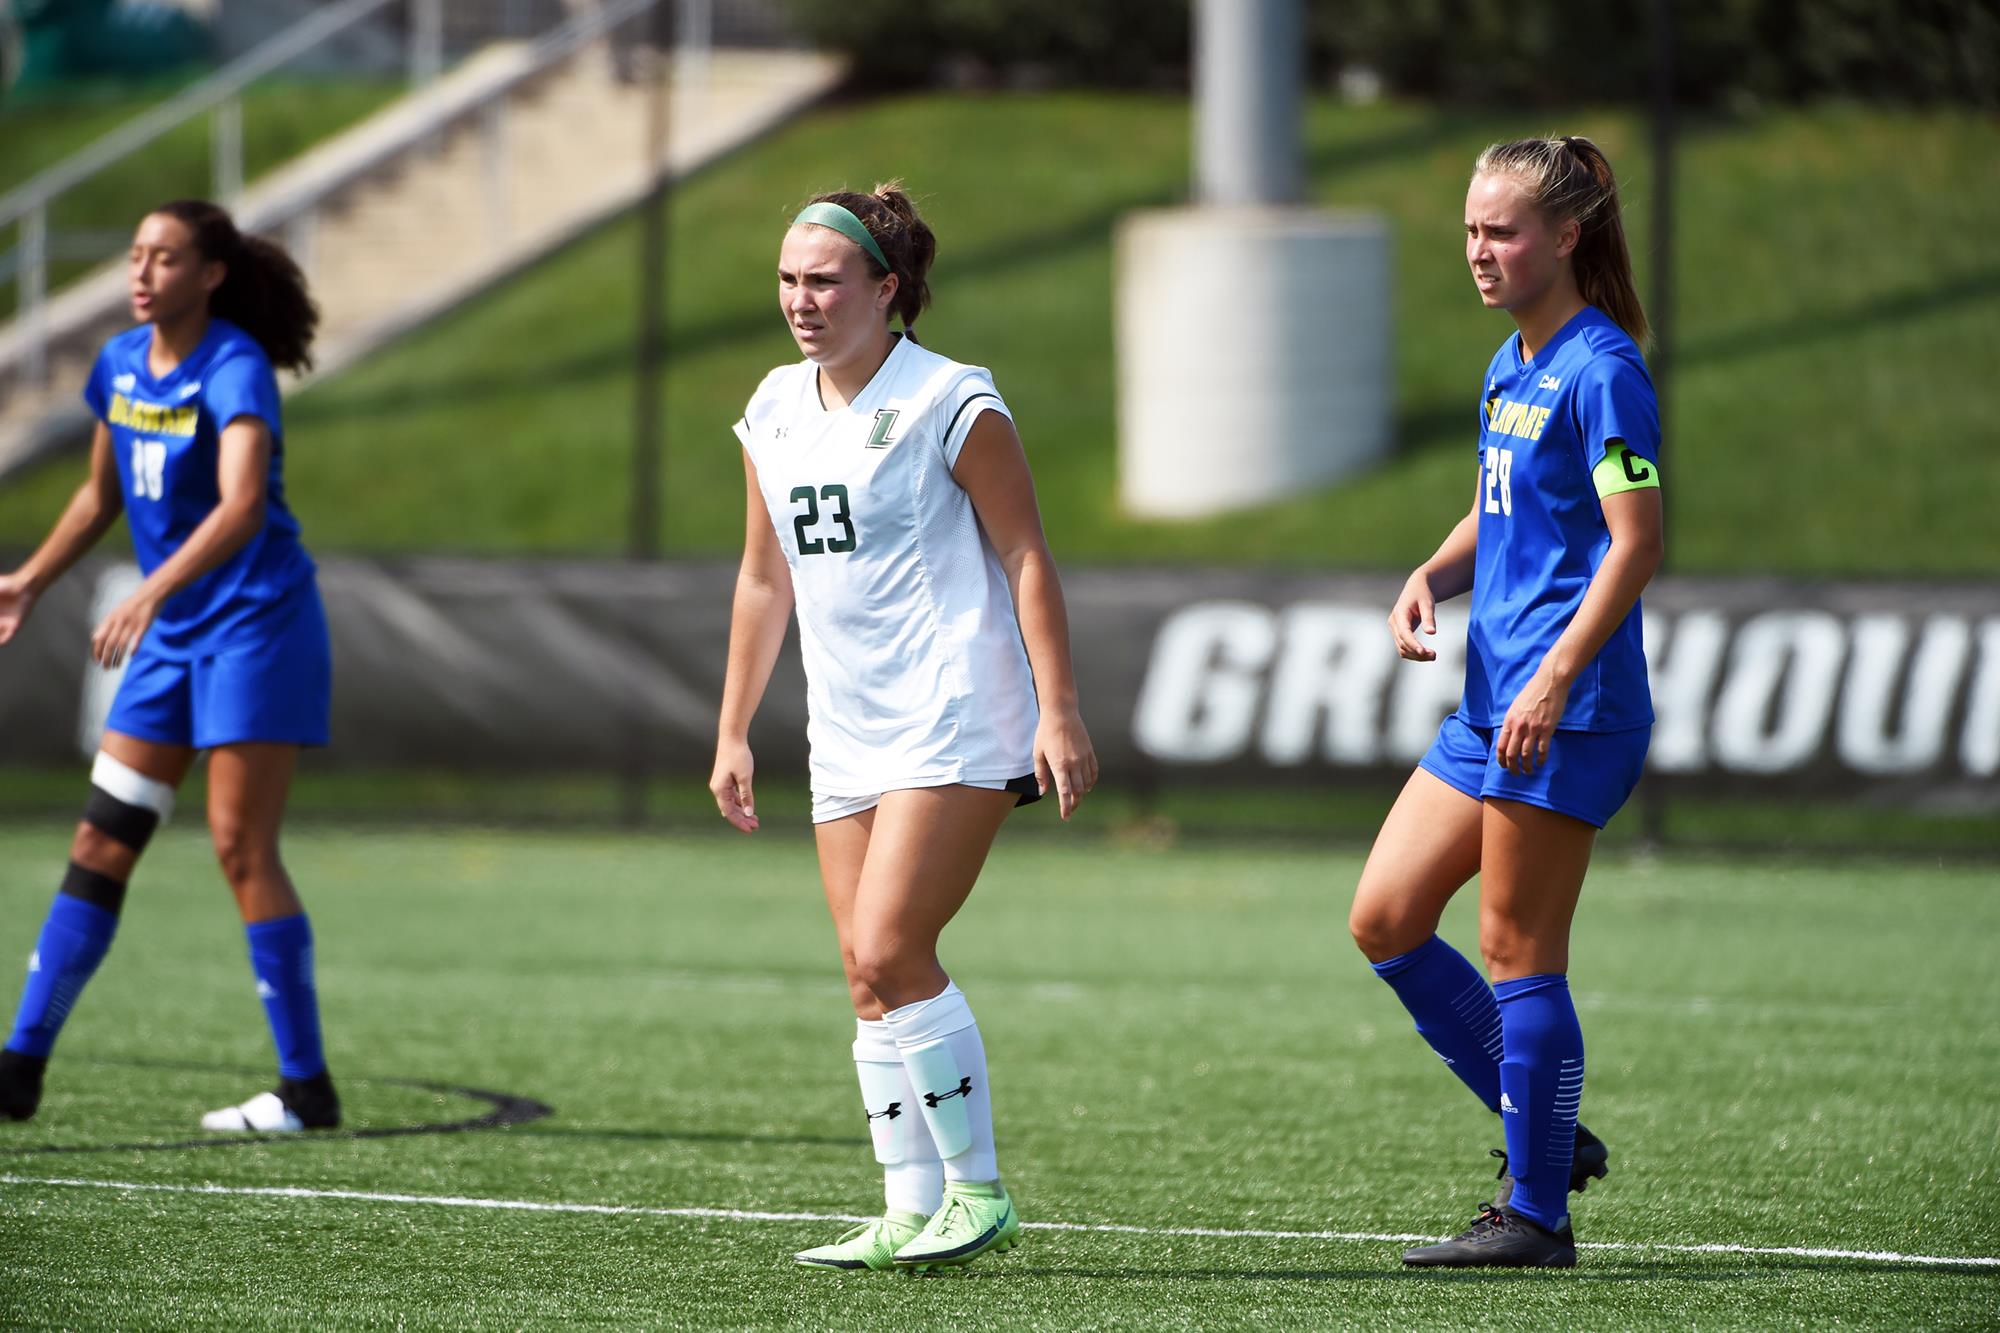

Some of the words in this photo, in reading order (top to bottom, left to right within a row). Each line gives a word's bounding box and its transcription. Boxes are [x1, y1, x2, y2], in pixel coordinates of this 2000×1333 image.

[865, 408, 900, 449] L
[1485, 446, 1513, 517] 28
[1621, 449, 1649, 482] C
[790, 484, 857, 555] 23
